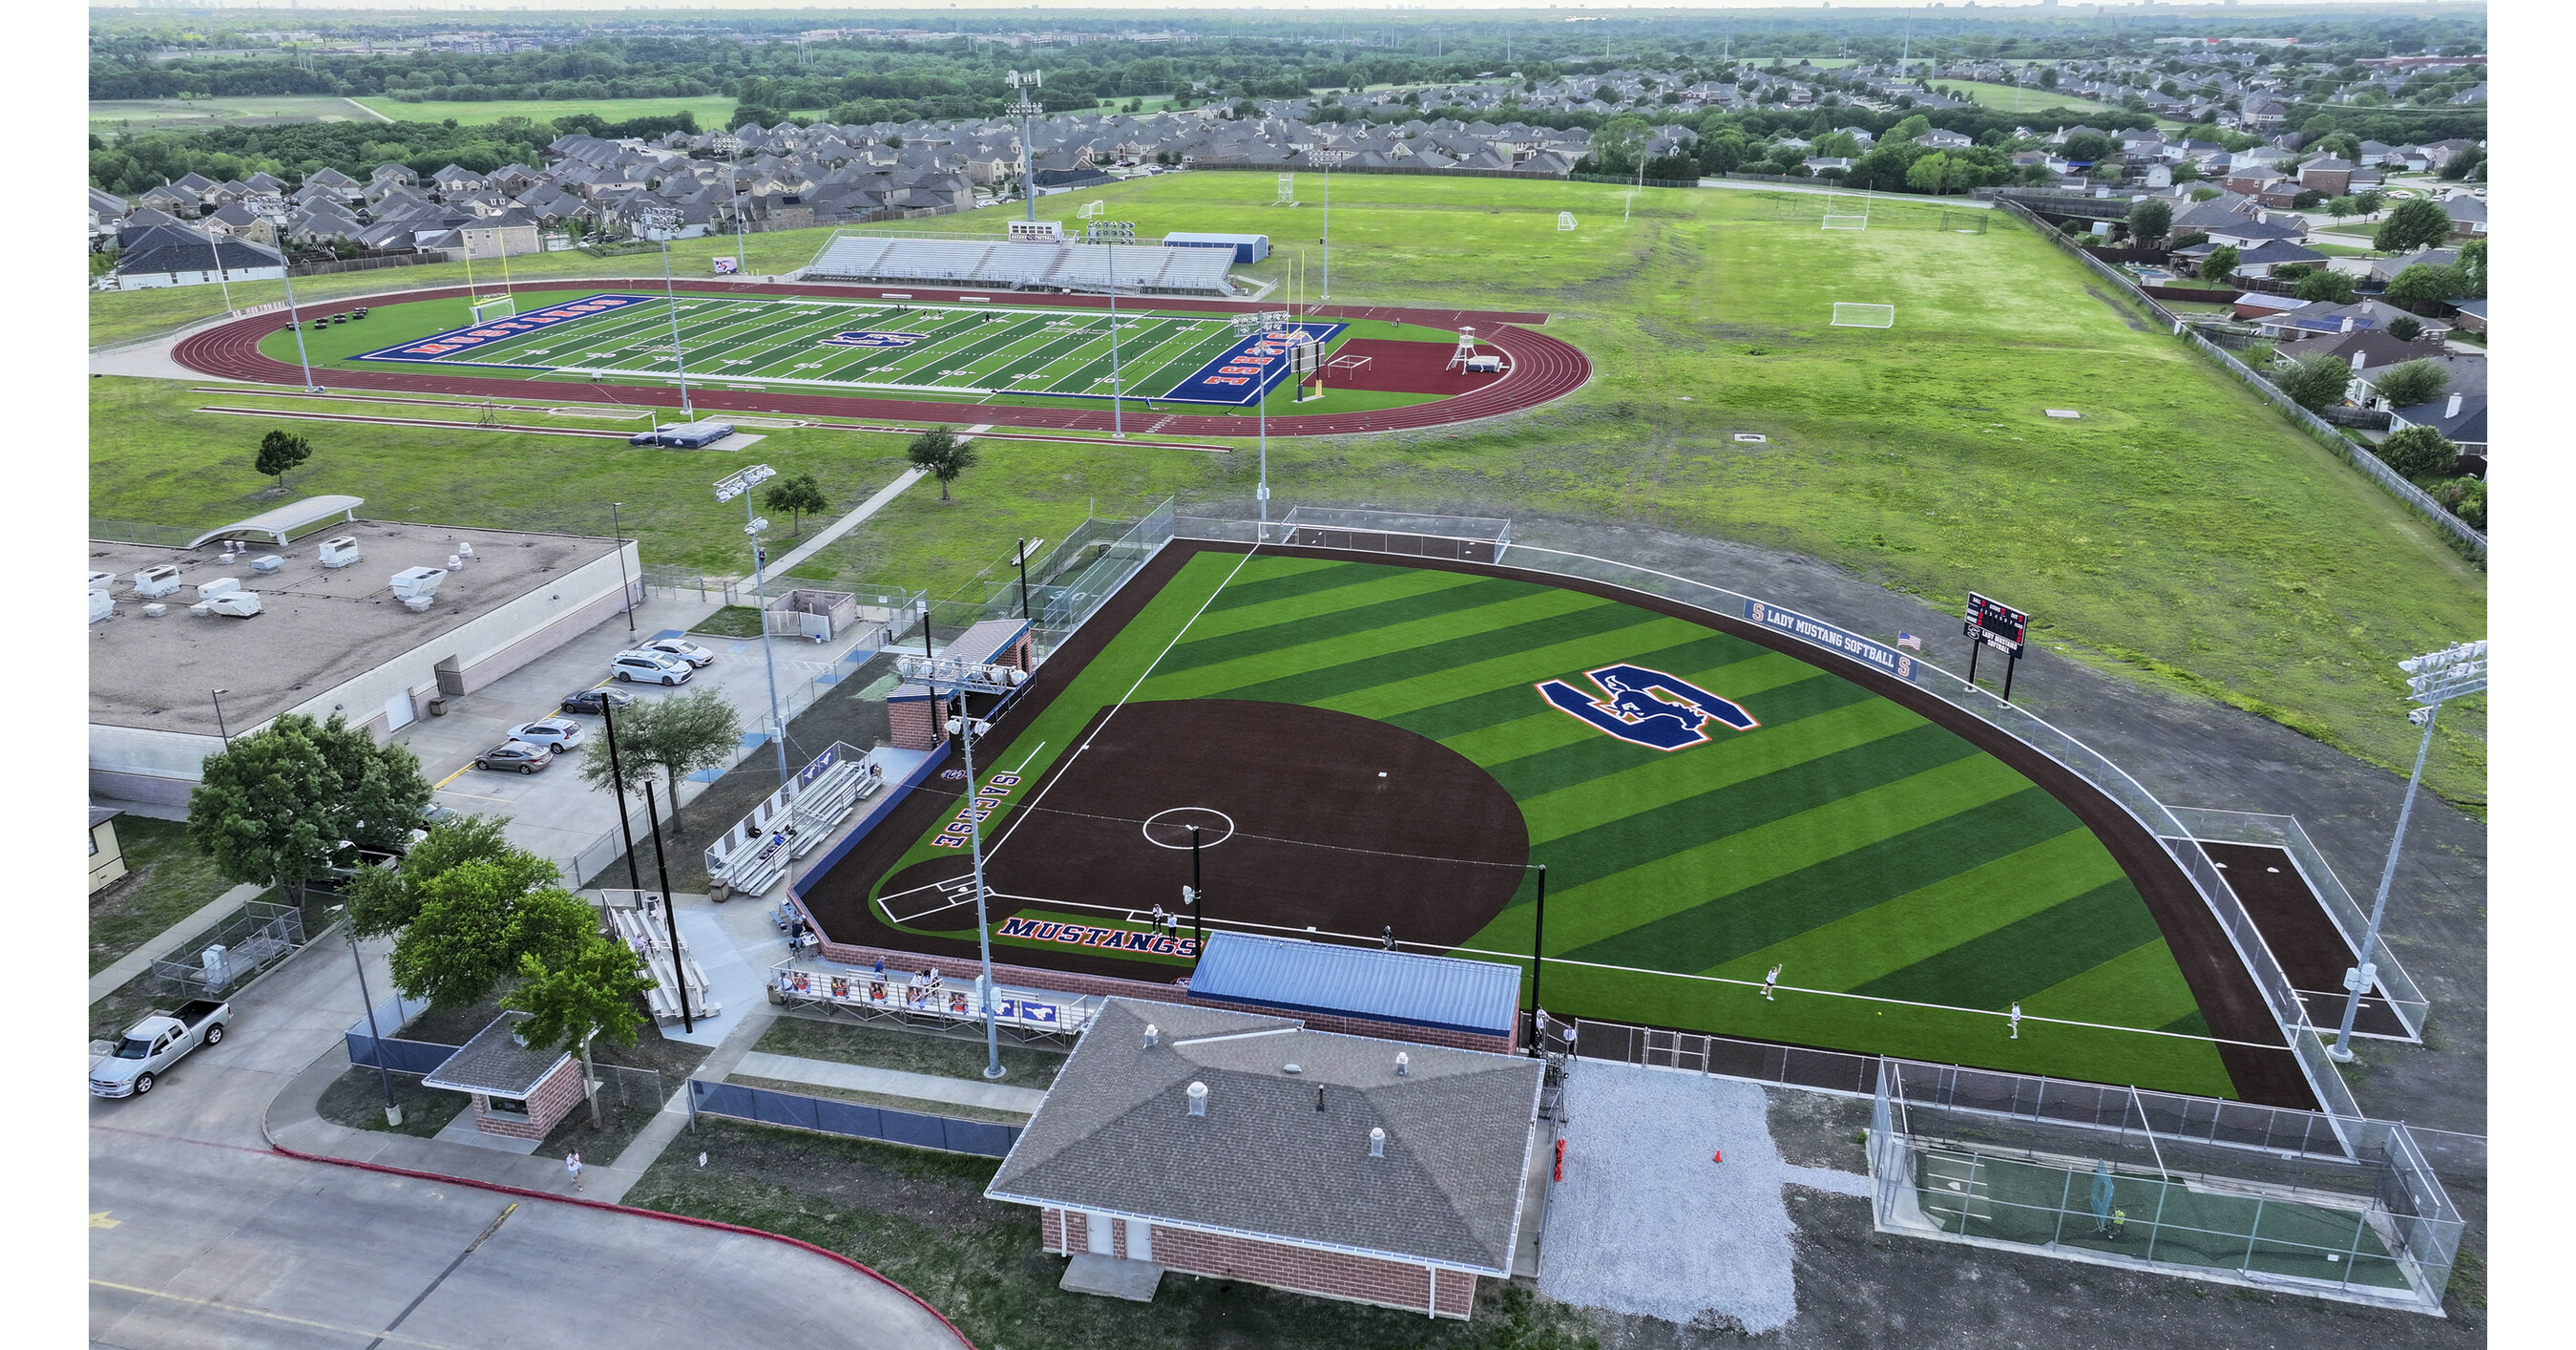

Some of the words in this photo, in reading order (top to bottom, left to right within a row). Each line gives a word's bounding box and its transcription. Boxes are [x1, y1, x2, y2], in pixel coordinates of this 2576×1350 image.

[403, 300, 627, 354] MUSTANGS
[1752, 602, 1765, 622] S
[1767, 610, 1794, 629] LADY
[1796, 620, 1843, 647] MUSTANG
[1844, 637, 1895, 668] SOFTBALL
[1897, 656, 1911, 677] S
[1982, 630, 1994, 640] LADY
[1995, 635, 2018, 650] MUSTANG
[1987, 639, 2009, 654] SOFTBALL
[930, 774, 1022, 848] SACHSE
[995, 917, 1204, 959] MUSTANGS
